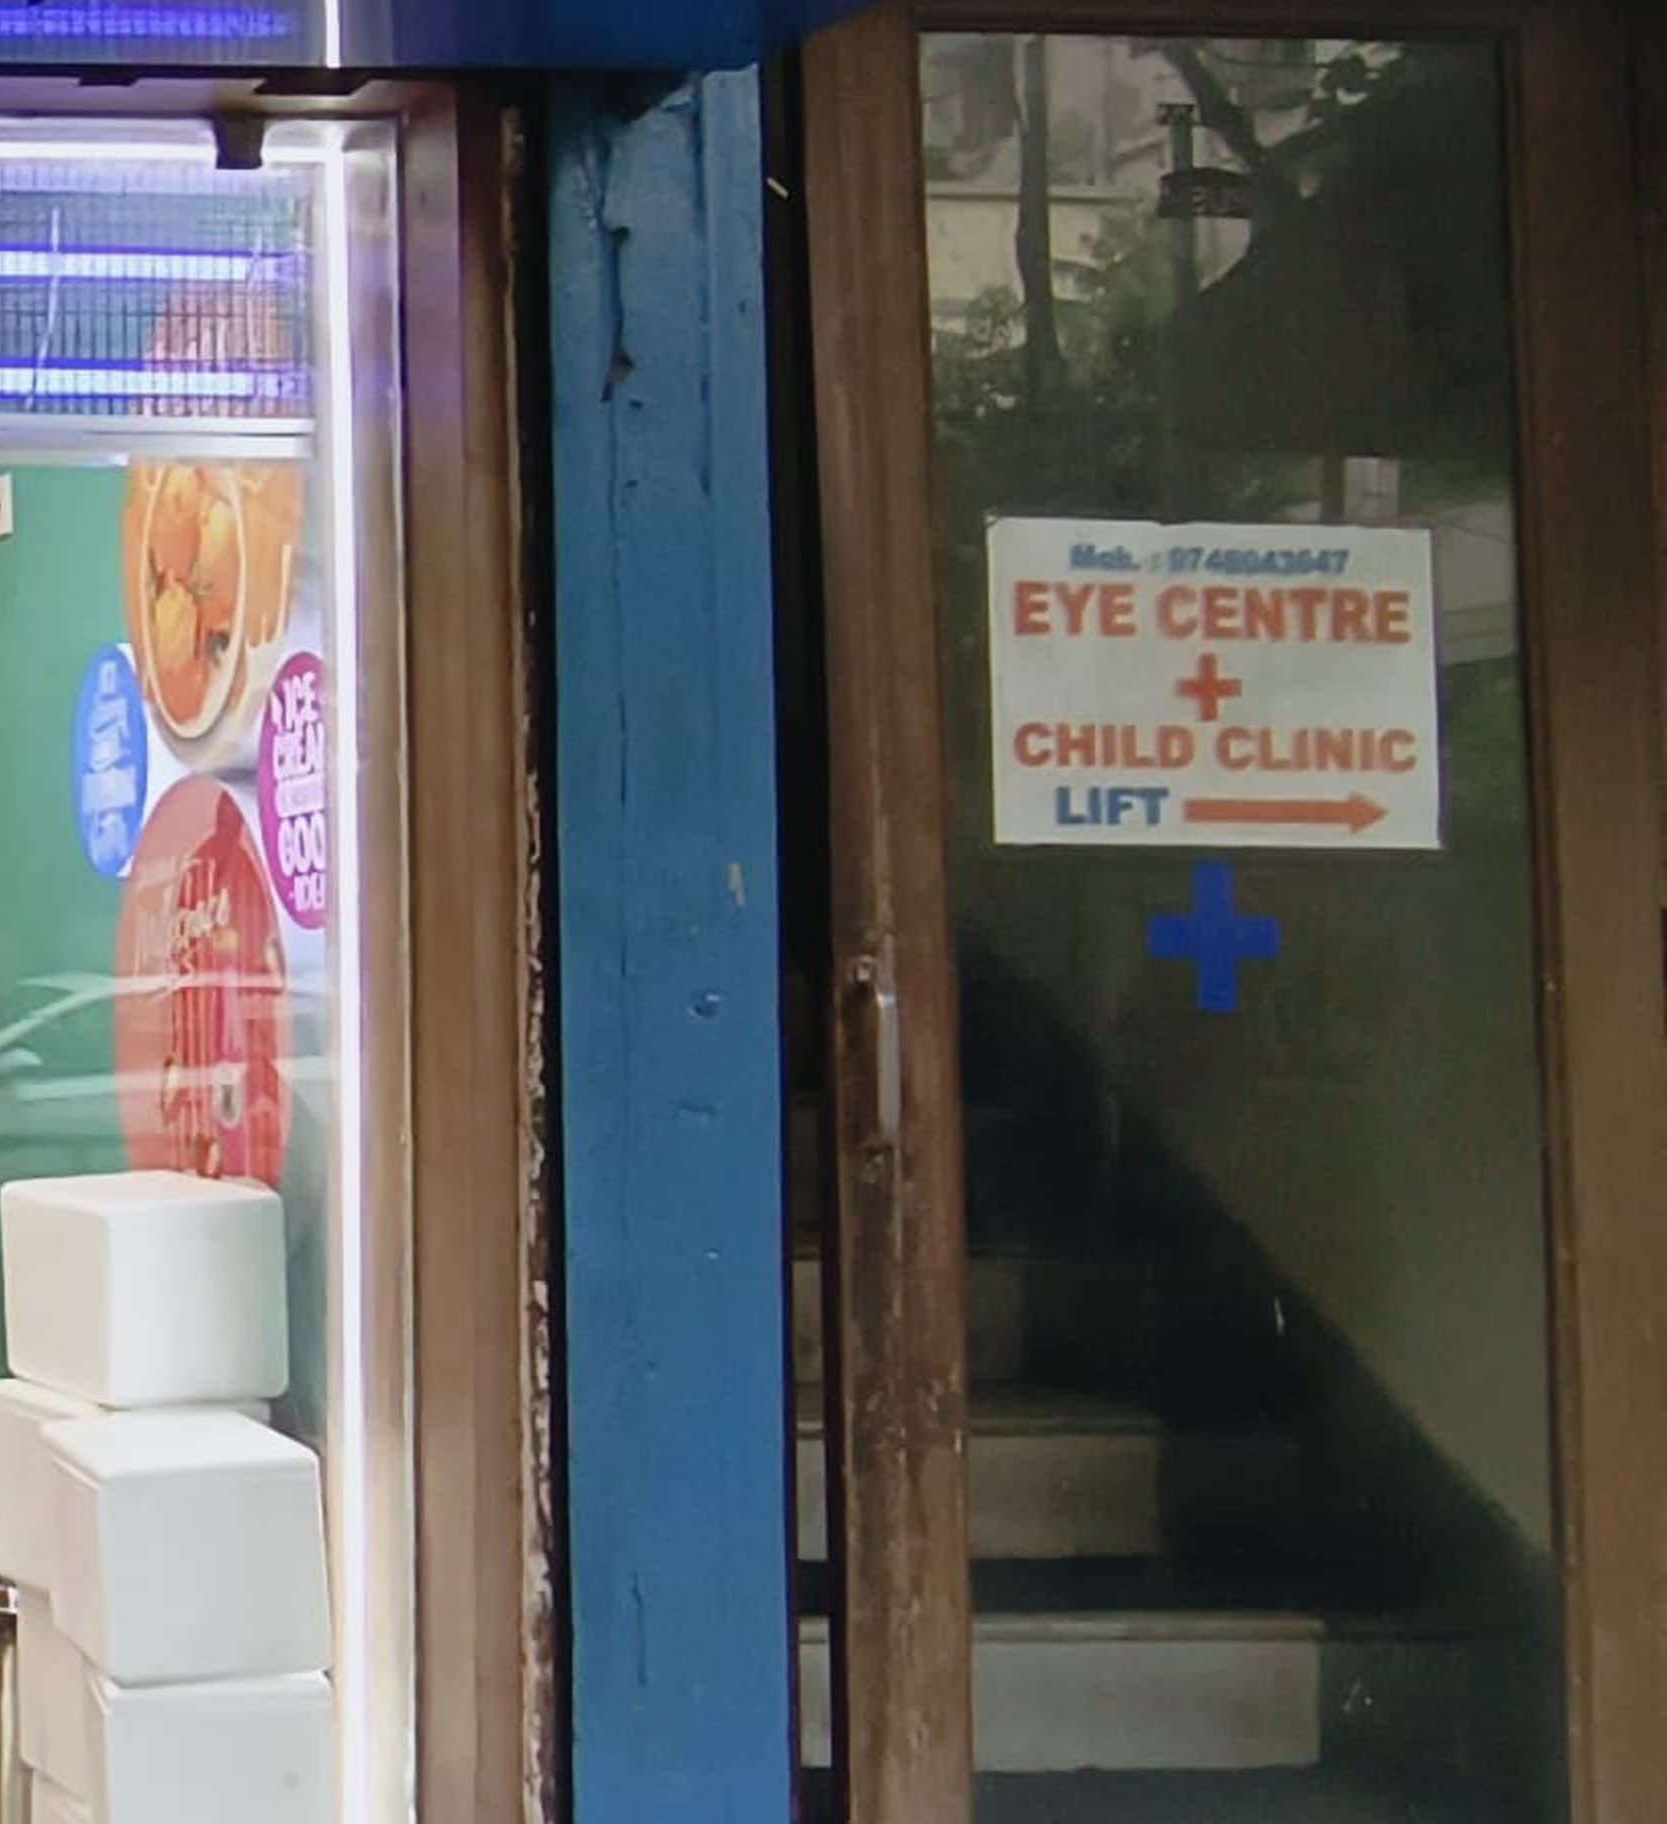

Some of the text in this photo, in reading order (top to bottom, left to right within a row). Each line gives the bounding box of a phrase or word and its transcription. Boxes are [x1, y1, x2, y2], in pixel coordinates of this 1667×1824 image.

[1013, 580, 1411, 644] EYE CENTRE
[1013, 722, 1419, 774] CHILD CLINIC
[1055, 787, 1170, 827] LIFT
